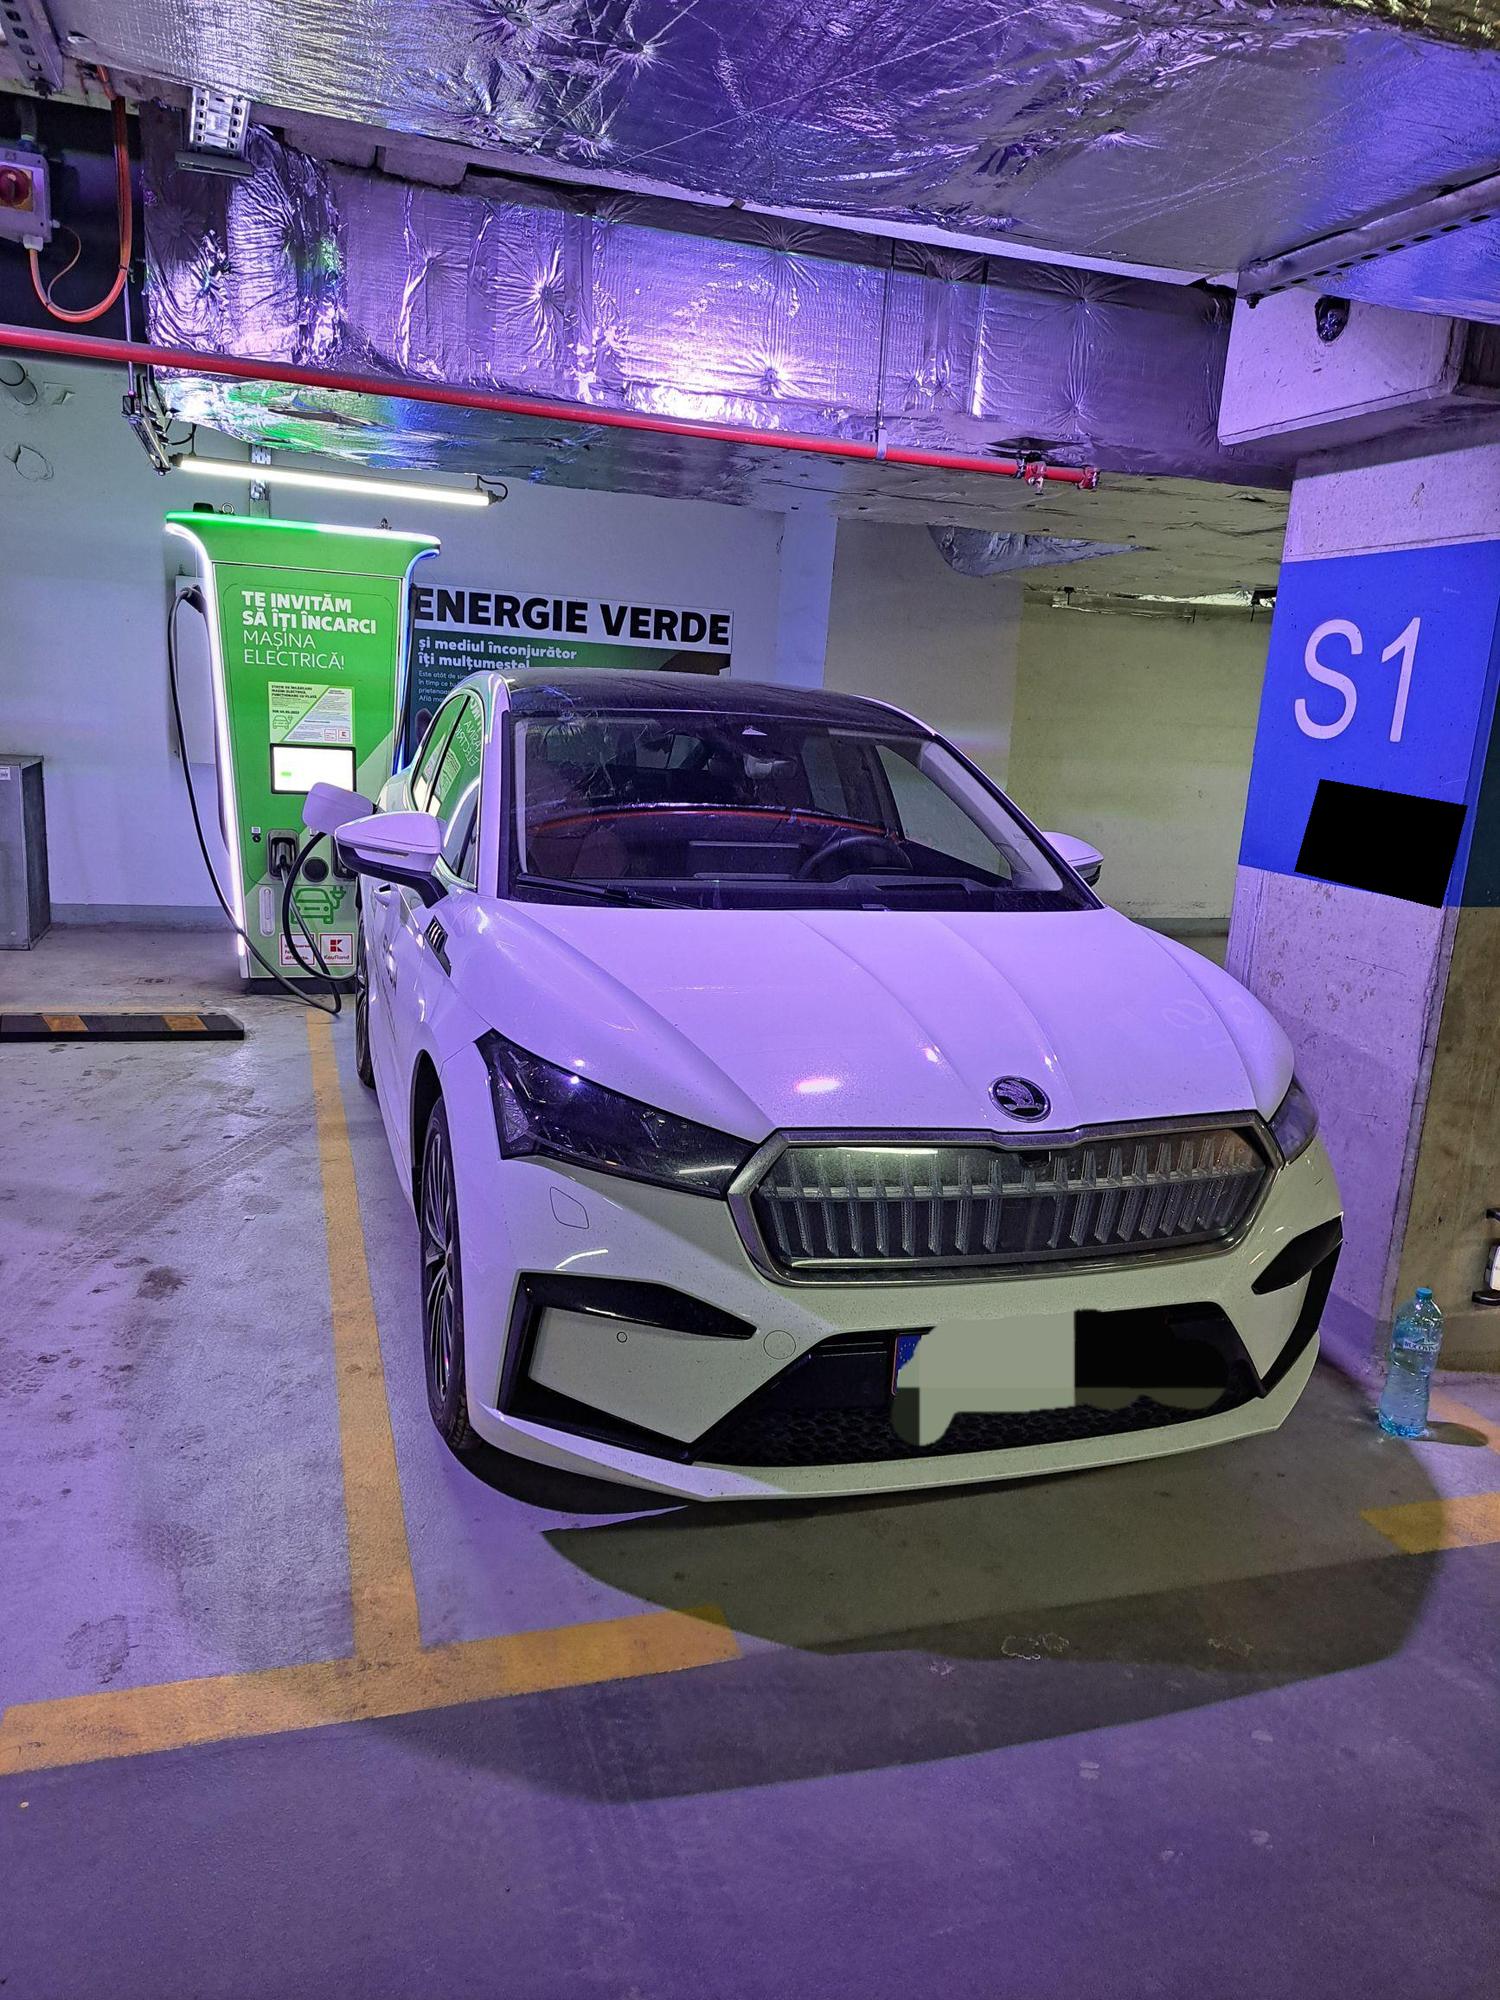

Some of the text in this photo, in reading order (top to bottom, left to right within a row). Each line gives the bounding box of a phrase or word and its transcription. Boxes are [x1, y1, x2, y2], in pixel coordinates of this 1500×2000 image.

[241, 590, 352, 613] TE INVITĂM
[242, 607, 268, 627] SĂ
[300, 611, 376, 634] ÎNCARCI
[416, 587, 731, 646] ENERGIE VERDE
[243, 630, 316, 650] MAȘINA
[418, 637, 577, 660] și mediul înconjurător
[244, 649, 344, 670] ELECTRICĂ!
[1294, 617, 1421, 742] S1
